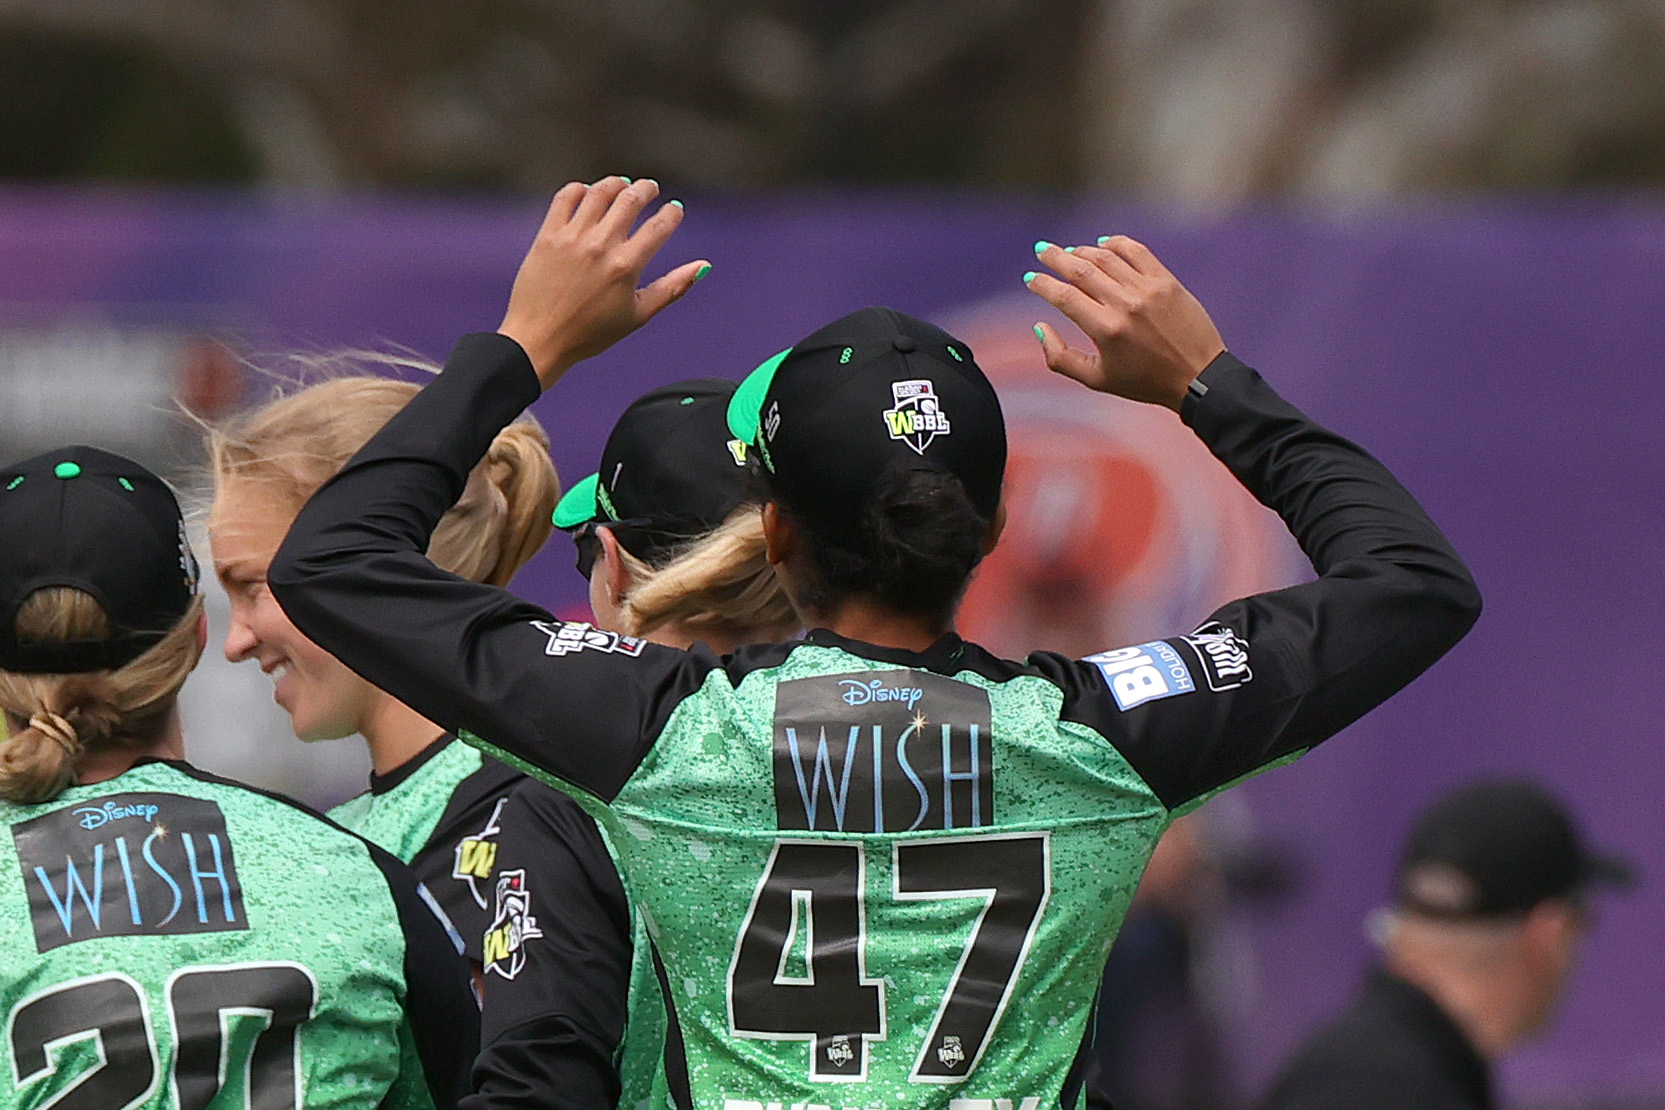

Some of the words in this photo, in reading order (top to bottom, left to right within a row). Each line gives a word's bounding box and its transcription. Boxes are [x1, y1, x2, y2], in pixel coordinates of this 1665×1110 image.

[885, 410, 947, 435] WBBL
[785, 722, 981, 833] WISH
[34, 832, 237, 938] WISH
[725, 831, 1051, 1083] 47
